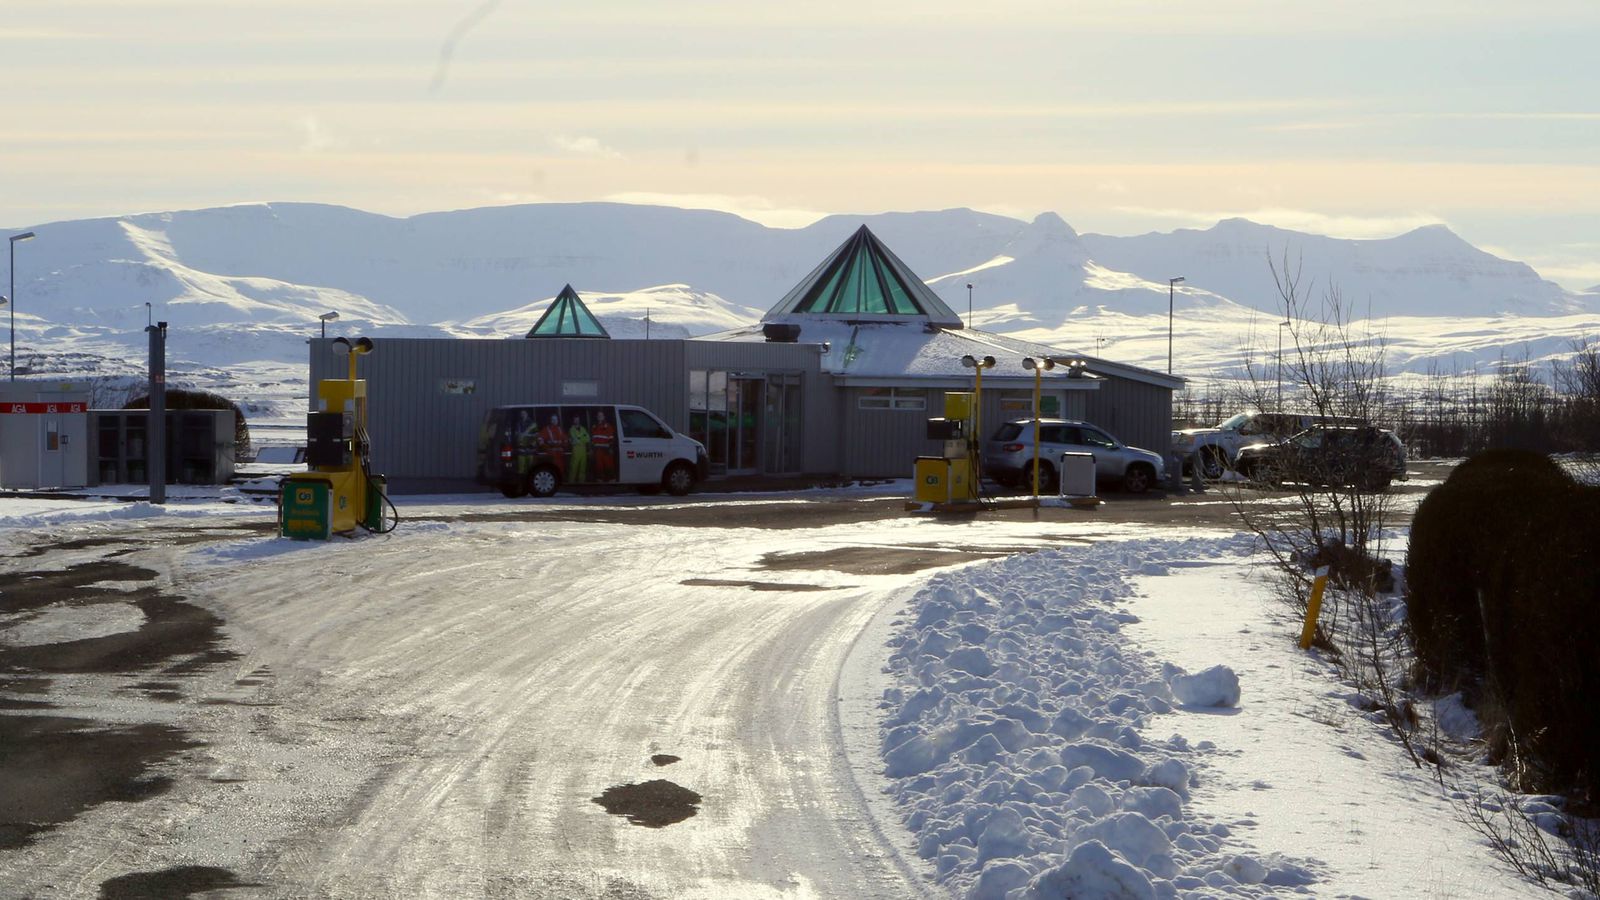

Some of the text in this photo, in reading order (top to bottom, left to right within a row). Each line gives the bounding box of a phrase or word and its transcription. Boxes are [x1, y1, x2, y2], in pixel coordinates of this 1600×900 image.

[12, 403, 26, 413] AGA
[47, 403, 57, 413] AGA
[71, 403, 80, 413] AGA
